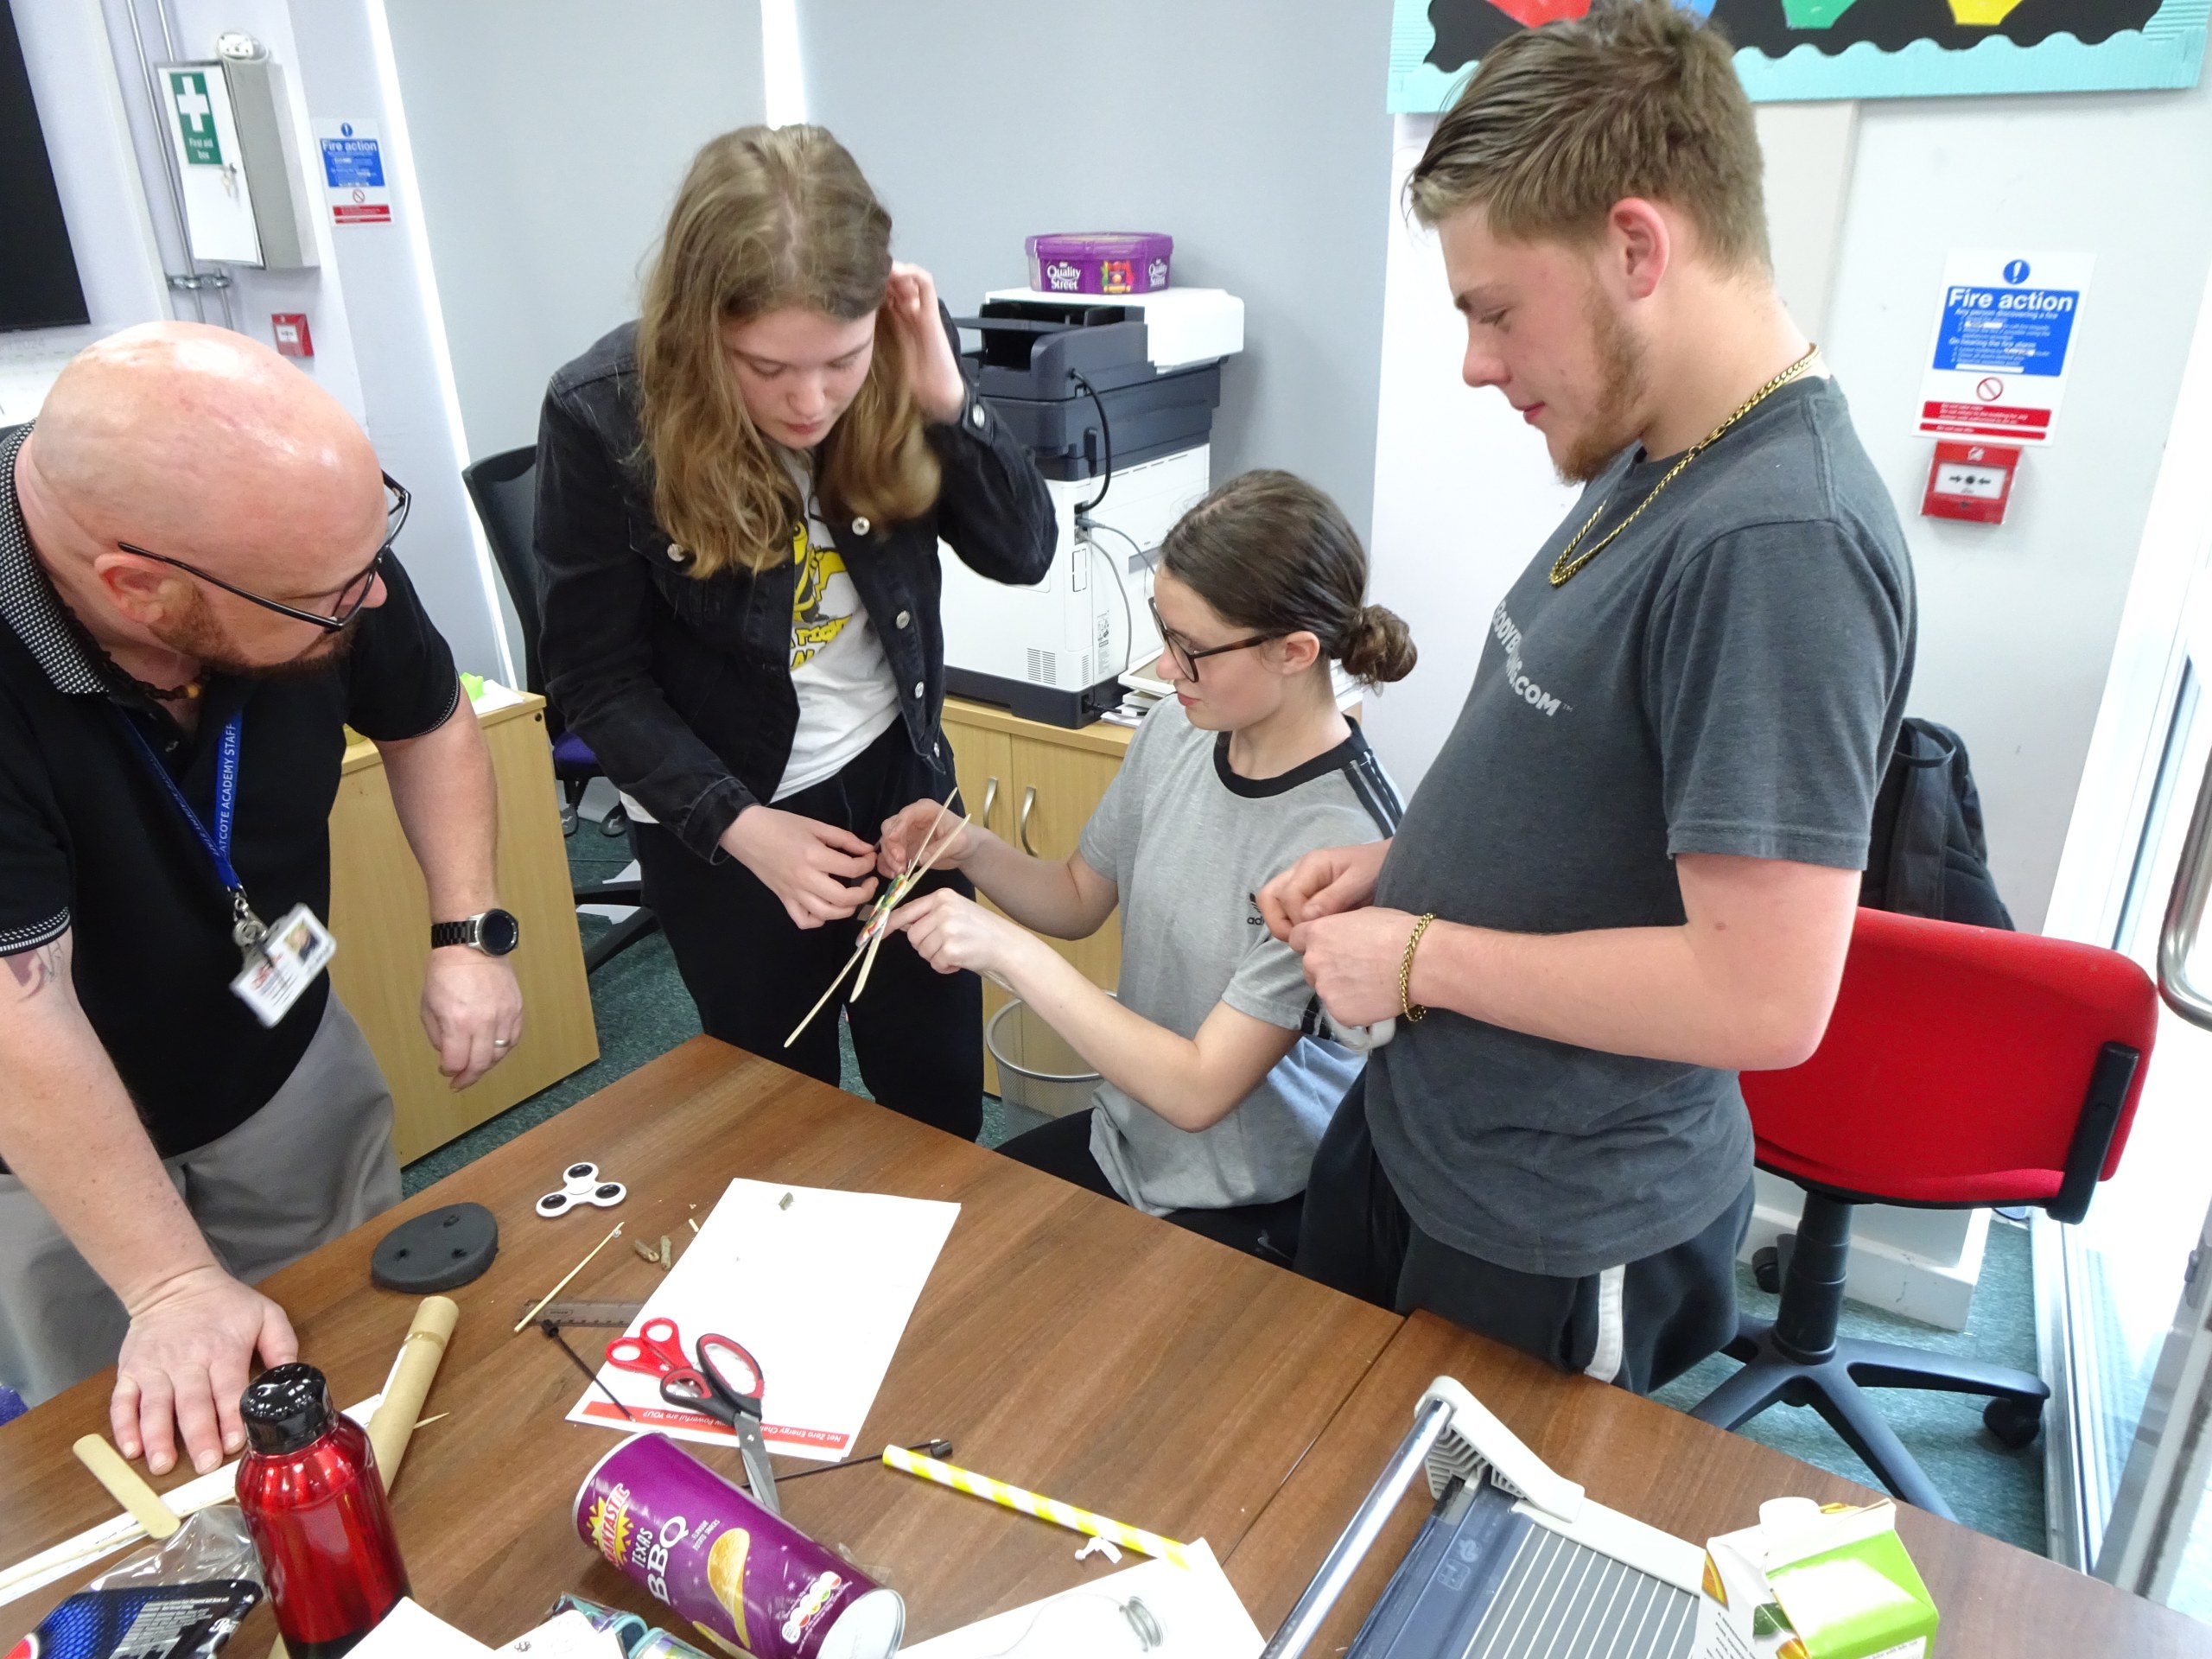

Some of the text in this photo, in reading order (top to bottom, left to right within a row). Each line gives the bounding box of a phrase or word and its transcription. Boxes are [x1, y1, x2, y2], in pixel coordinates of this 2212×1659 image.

[321, 140, 378, 151] Fire action
[1047, 264, 1081, 279] Quality
[1051, 277, 1078, 290] Street
[1948, 288, 2073, 312] Fire action
[225, 723, 237, 756] STAFF
[221, 758, 235, 810] ACADEMY
[643, 1410, 664, 1420] YOU?
[679, 1414, 714, 1427] Powerful
[779, 1426, 807, 1439] Energy
[808, 1431, 826, 1441] Zero
[827, 1433, 842, 1443] Net
[632, 1527, 653, 1568] TEXAS
[646, 1516, 690, 1606] BBQ
